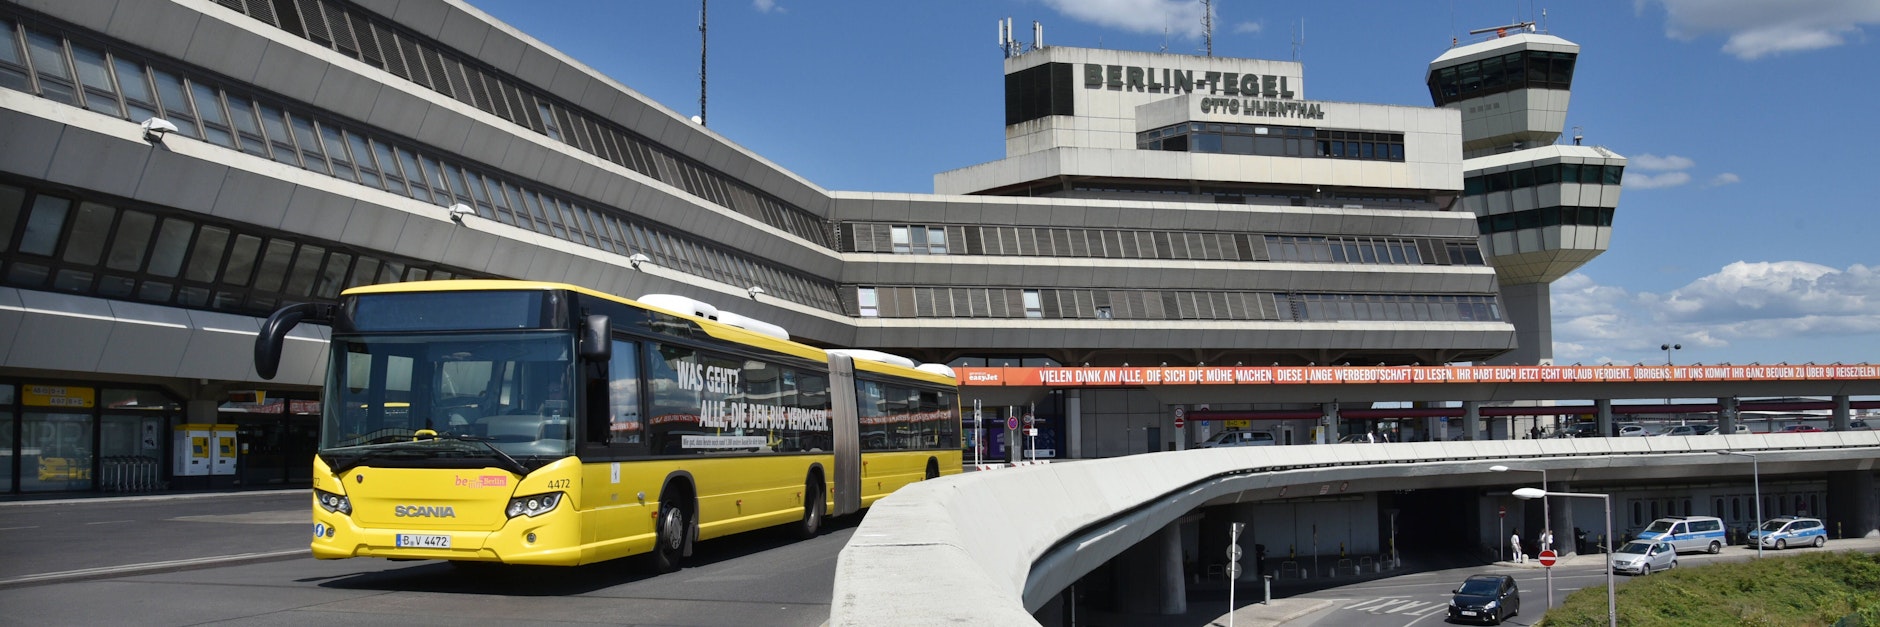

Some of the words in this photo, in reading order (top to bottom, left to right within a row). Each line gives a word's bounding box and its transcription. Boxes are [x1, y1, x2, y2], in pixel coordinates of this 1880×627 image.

[1084, 63, 1294, 99] BERLIN-TEGEL
[1200, 97, 1240, 116] OTTO
[1243, 99, 1325, 120] LILIENTHAL
[677, 360, 704, 392] WAS
[706, 365, 740, 396] GEHT?
[969, 373, 998, 382] easyJet
[1039, 370, 1072, 382] VIELEN
[1075, 370, 1101, 382] DANK
[1103, 370, 1116, 382] AN
[1119, 370, 1144, 383] ALLE,
[1146, 369, 1161, 382] DIE
[1164, 369, 1186, 382] SICH
[1188, 369, 1204, 382] DIE
[1206, 368, 1232, 381] MÜHE
[1277, 369, 1302, 381] DIESE
[1305, 369, 1332, 381] LANGE
[1335, 369, 1412, 381] WERBEBOTSCHAFT
[1414, 368, 1424, 380] ZU
[1427, 368, 1454, 380] LESEN.
[1457, 368, 1470, 380] IHR
[1473, 368, 1493, 380] HABT
[1496, 368, 1516, 380] EUCH
[1518, 368, 1540, 380] JETZT
[1541, 368, 1560, 380] ECHT
[1562, 368, 1593, 380] URLAUB
[1594, 368, 1631, 379] VERDIENT.
[1674, 367, 1686, 379] MIT
[1688, 367, 1703, 379] UNS
[1705, 367, 1731, 379] KOMMT
[1732, 367, 1745, 379] IHR
[1746, 367, 1764, 379] GANZ
[1766, 367, 1794, 379] BEQUEM
[1795, 367, 1805, 378] ZU
[1806, 366, 1824, 378] ÜBER
[1826, 367, 1835, 378] 90
[1836, 367, 1876, 378] REISEZIELEN
[699, 399, 729, 432] ALLE,
[731, 402, 747, 428] DIE
[749, 403, 768, 429] DEN
[770, 404, 786, 430] BUS
[787, 406, 829, 431] VERPASSEN.
[455, 475, 468, 486] be
[483, 476, 505, 486] Berlin
[548, 478, 571, 490] 4472
[395, 505, 456, 518] SCANIA
[403, 535, 410, 546] B
[415, 535, 422, 546] V
[424, 536, 447, 547] 4472
